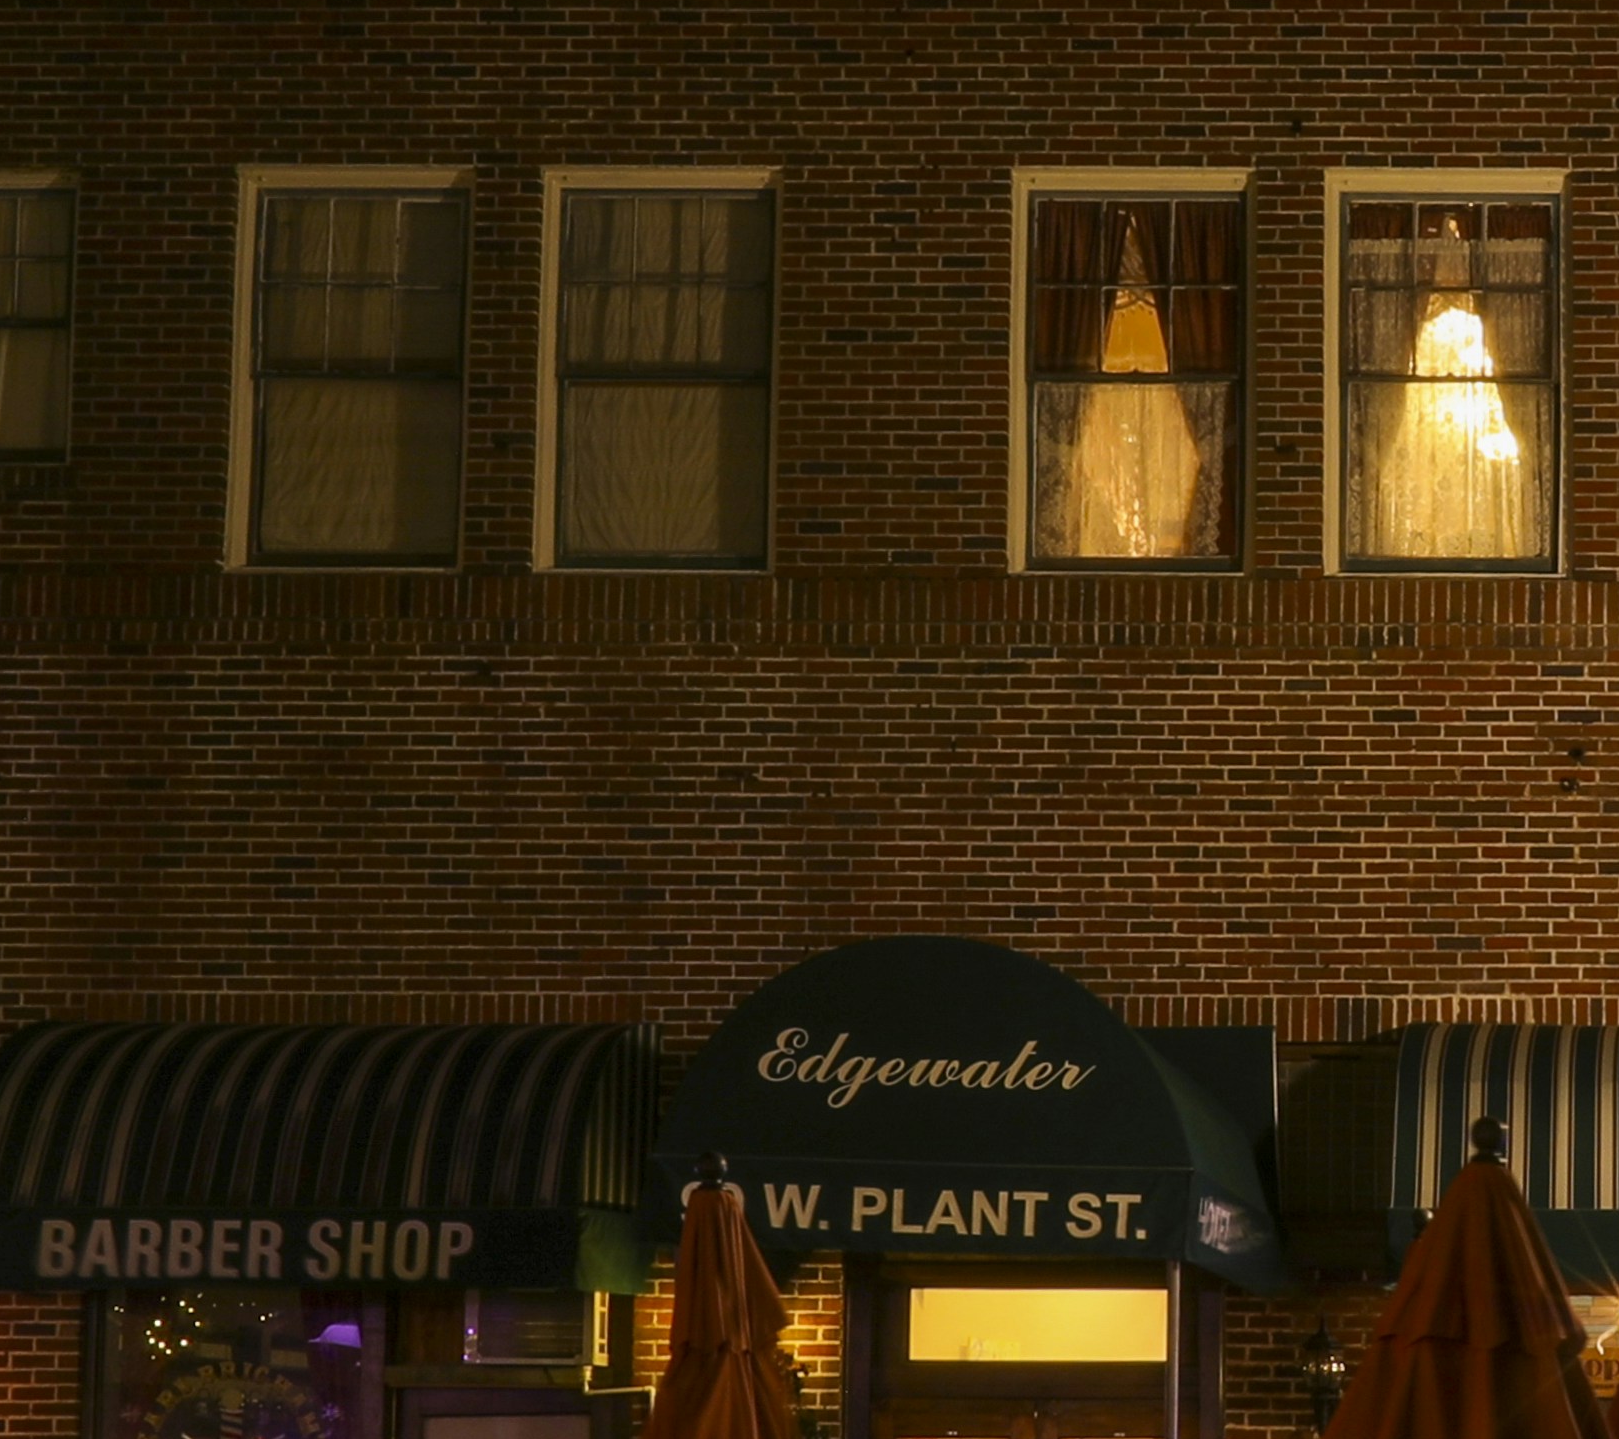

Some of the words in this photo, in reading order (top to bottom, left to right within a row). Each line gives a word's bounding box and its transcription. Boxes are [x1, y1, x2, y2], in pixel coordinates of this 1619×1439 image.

[758, 1027, 1096, 1108] Edgewater
[763, 1183, 829, 1231] W.
[851, 1185, 1050, 1237] PLANT
[1064, 1192, 1147, 1241] ST.
[36, 1218, 284, 1279] BARBER
[305, 1217, 476, 1281] SHOP
